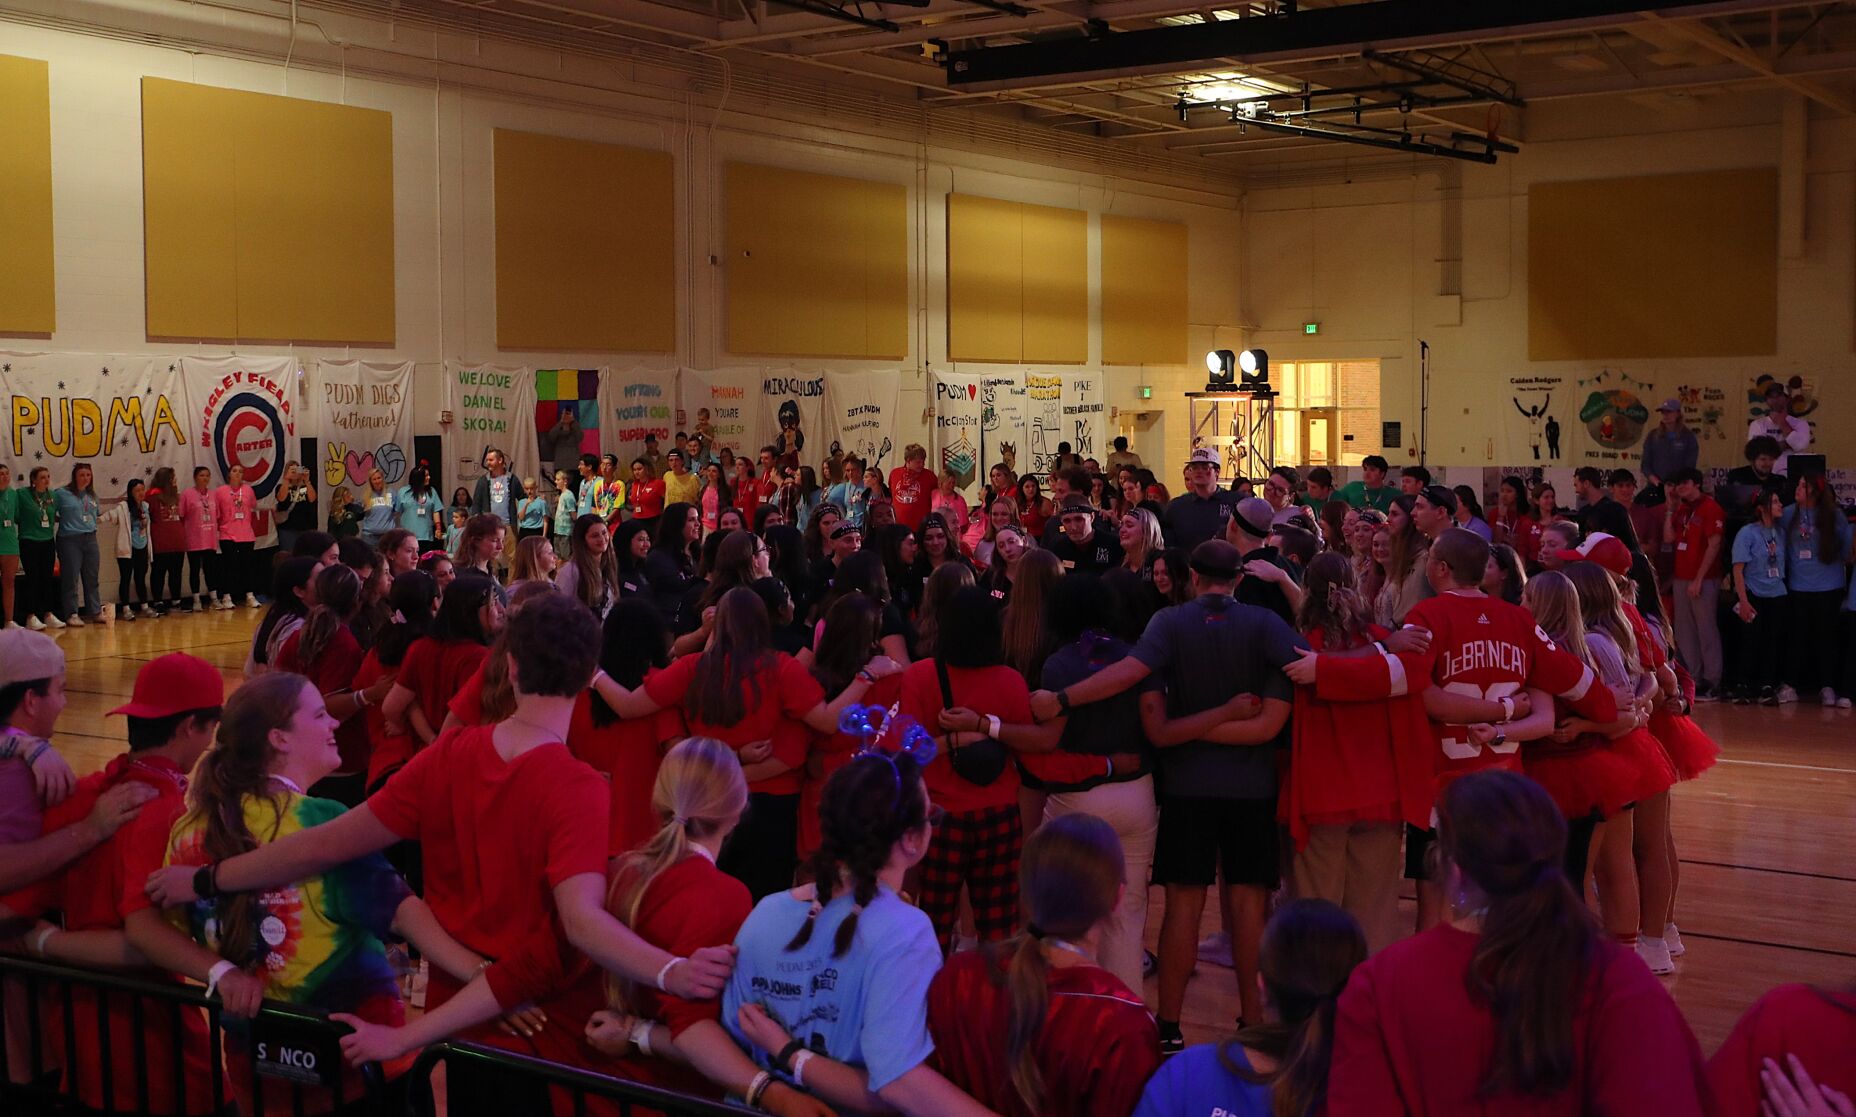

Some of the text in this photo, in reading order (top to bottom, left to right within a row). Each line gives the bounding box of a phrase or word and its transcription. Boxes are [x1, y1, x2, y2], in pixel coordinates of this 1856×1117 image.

[459, 371, 511, 389] WE LOVE
[764, 377, 824, 397] MIRACULOUS
[325, 382, 401, 405] PUDM DIGS
[937, 382, 967, 400] PUDM
[463, 394, 506, 410] DANIEL
[11, 394, 187, 457] PUDMA
[463, 416, 506, 433] SKORA!
[257, 1042, 316, 1069] SNCO
